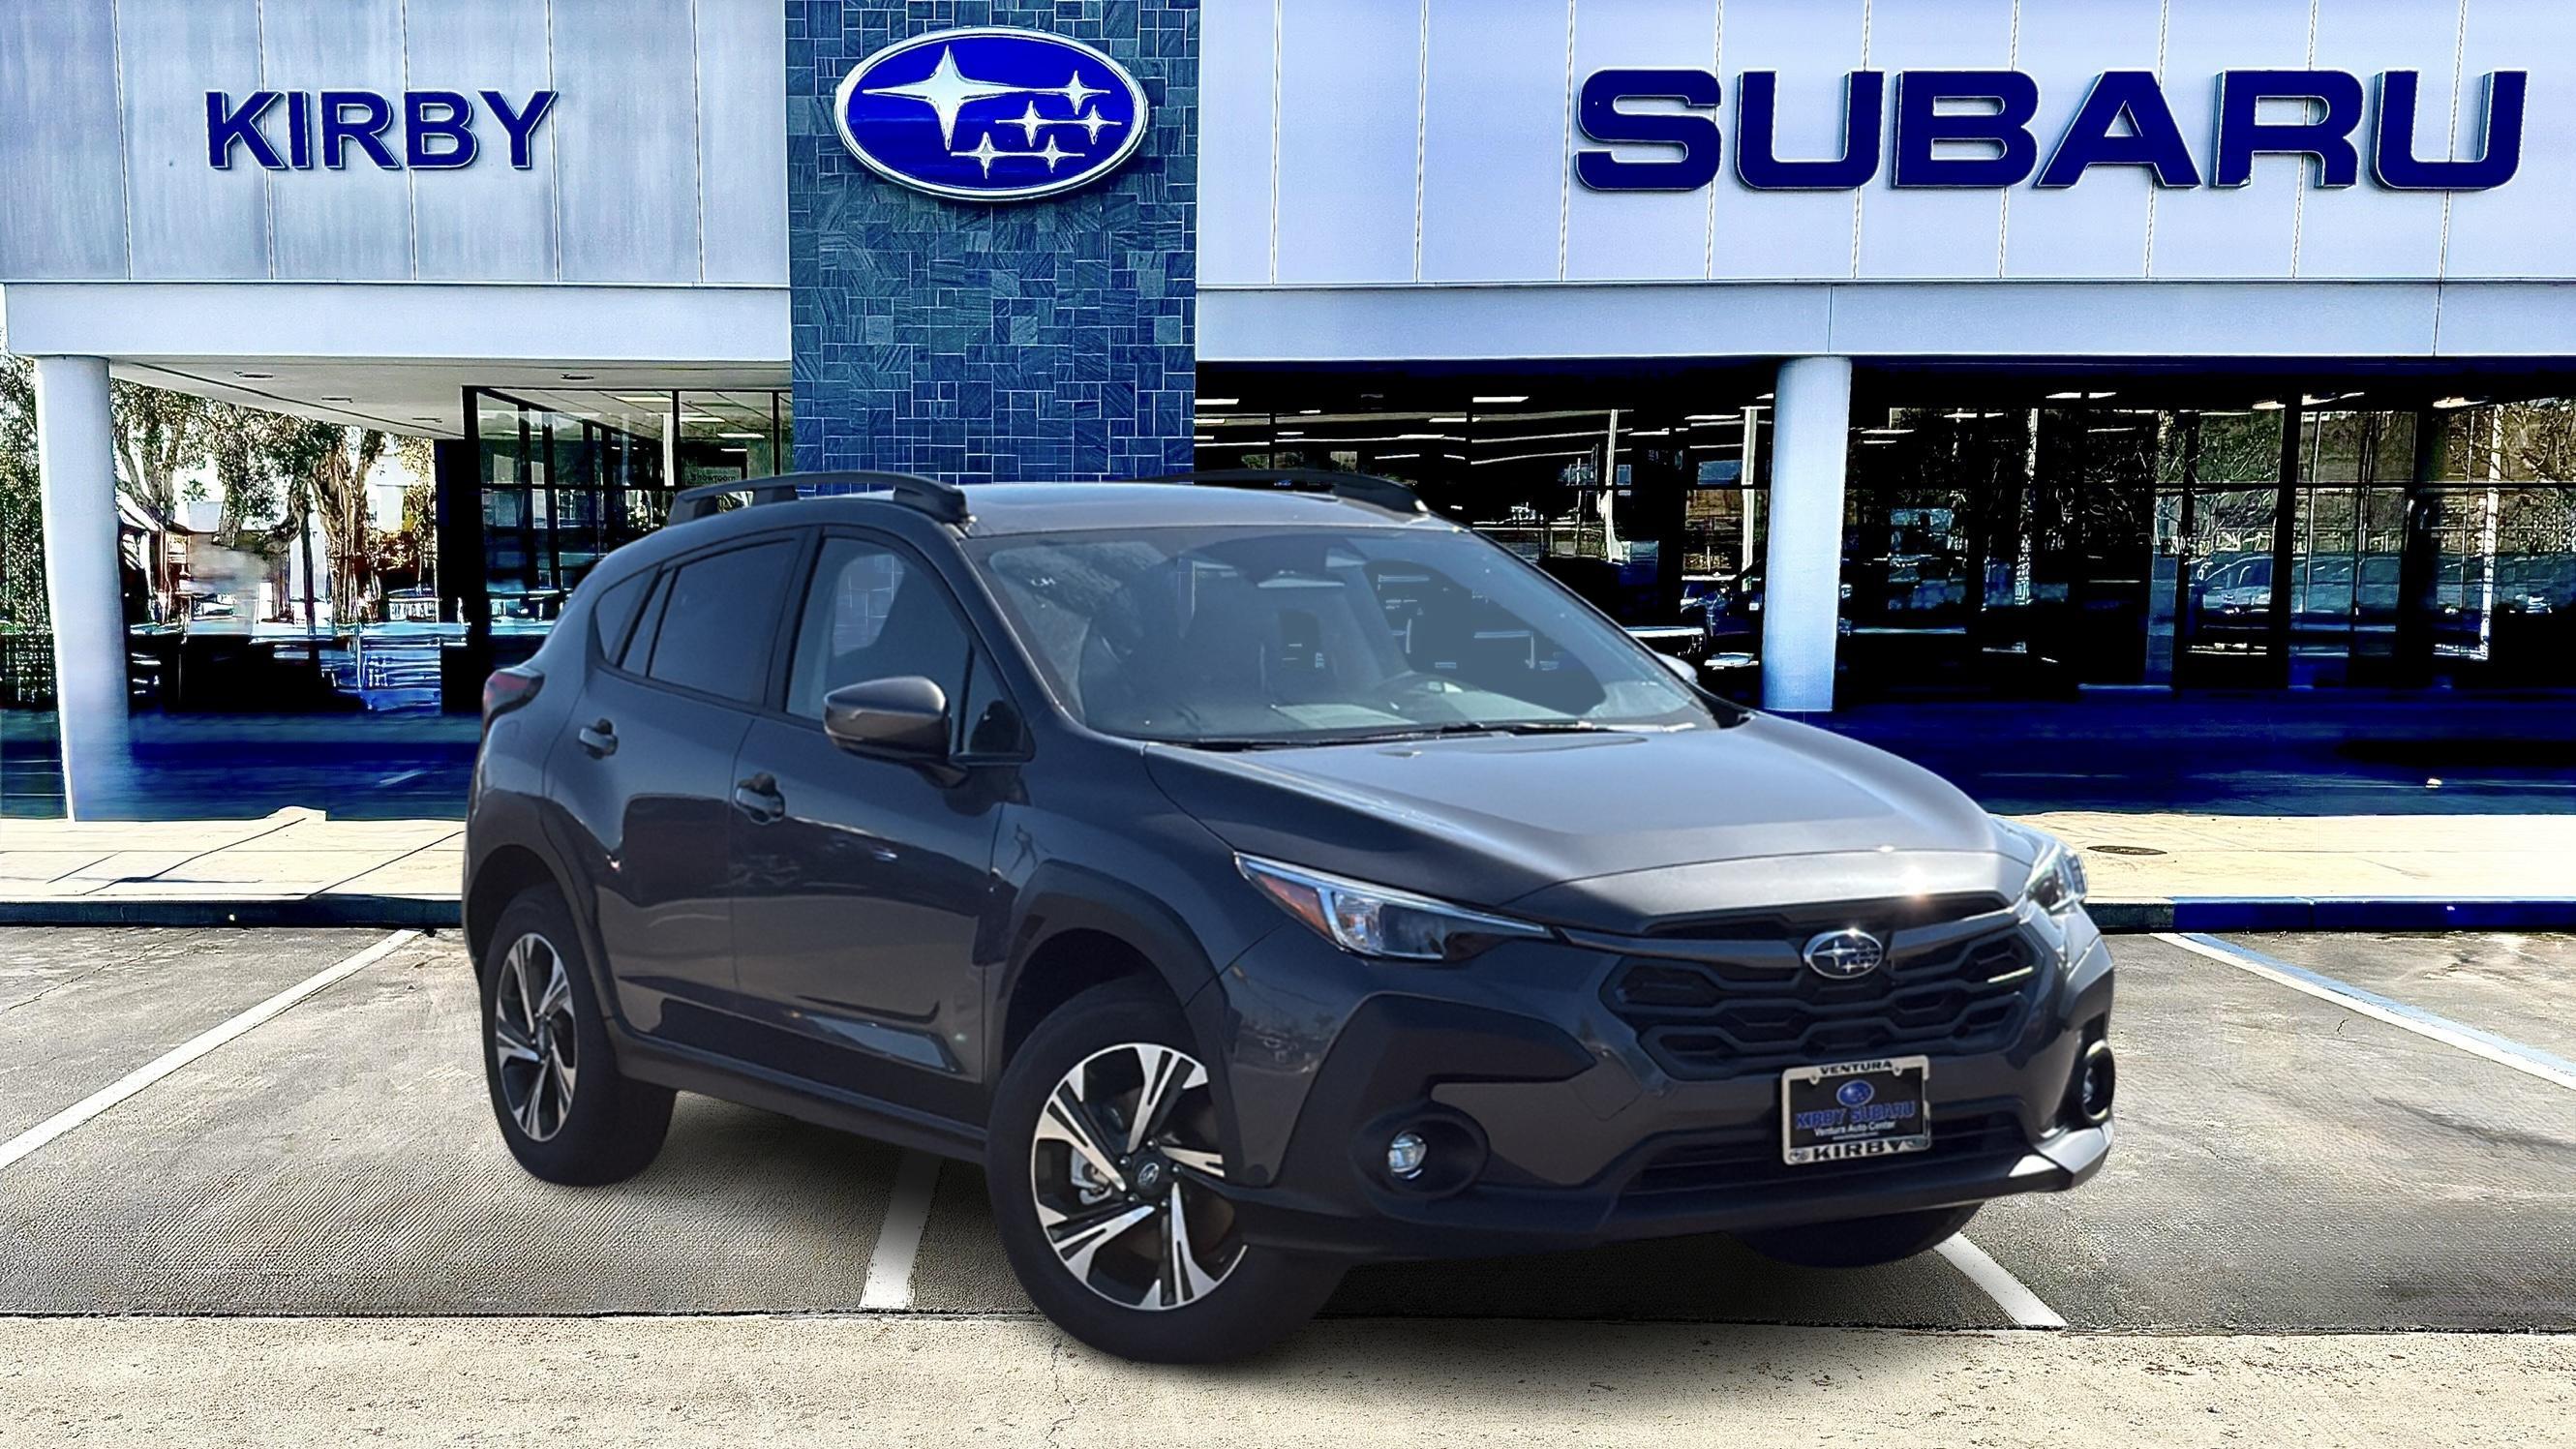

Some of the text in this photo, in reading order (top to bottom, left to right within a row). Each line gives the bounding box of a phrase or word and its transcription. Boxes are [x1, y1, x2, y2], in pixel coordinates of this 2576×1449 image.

[205, 91, 559, 170] KIRBY
[1575, 69, 2528, 191] SUBARU
[1820, 1060, 1893, 1074] VENTURA
[1796, 1102, 1916, 1130] KIRBY SUBARU
[1814, 1126, 1846, 1137] Ventura
[1847, 1122, 1866, 1132] Auto
[1868, 1121, 1895, 1131] Center
[1813, 1139, 1903, 1161] KIRBY
